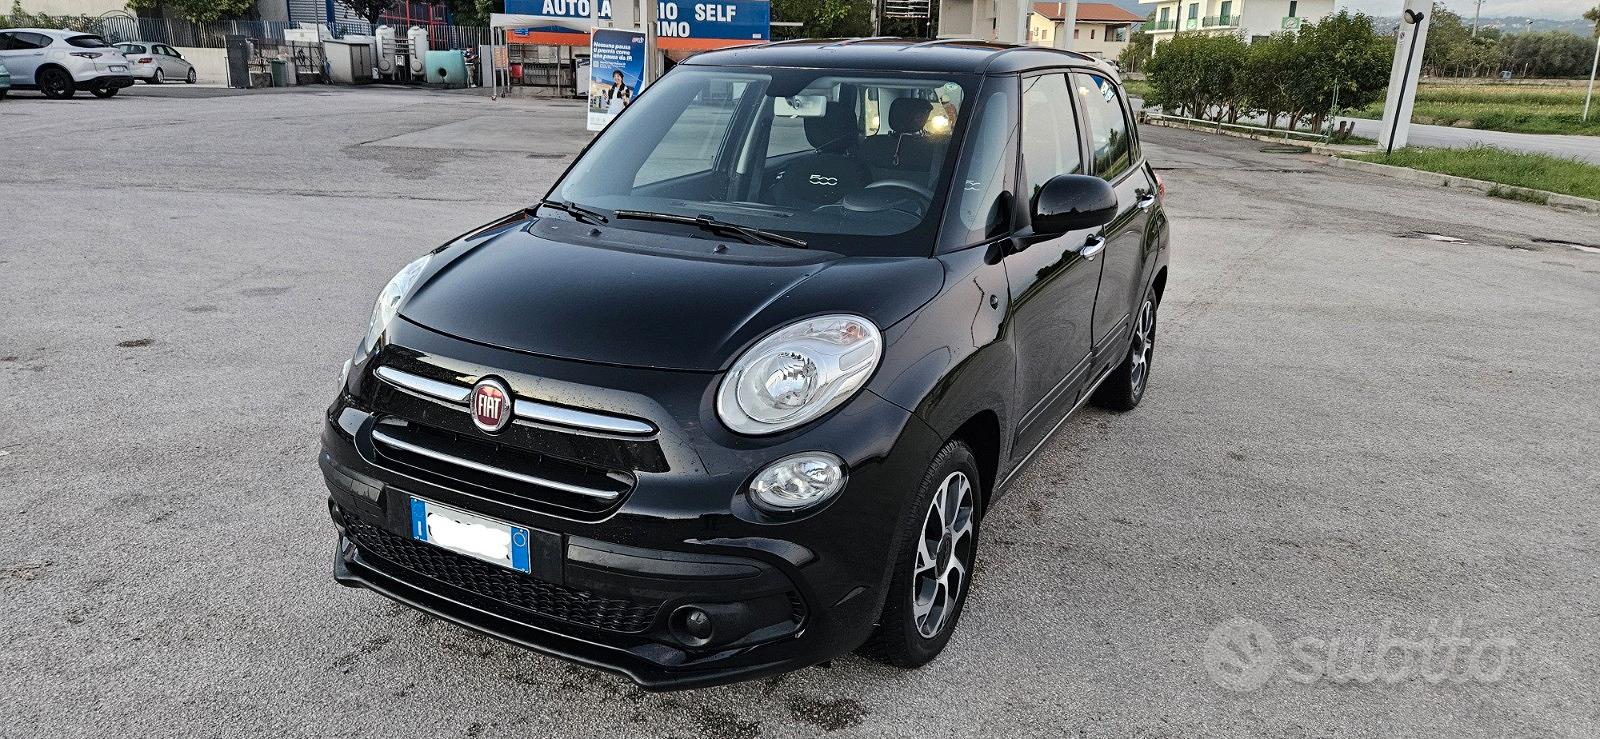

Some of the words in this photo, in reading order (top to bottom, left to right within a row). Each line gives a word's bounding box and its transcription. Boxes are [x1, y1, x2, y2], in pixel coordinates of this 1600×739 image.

[694, 3, 737, 22] SELF
[809, 174, 838, 186] 500
[478, 393, 502, 420] FIAT
